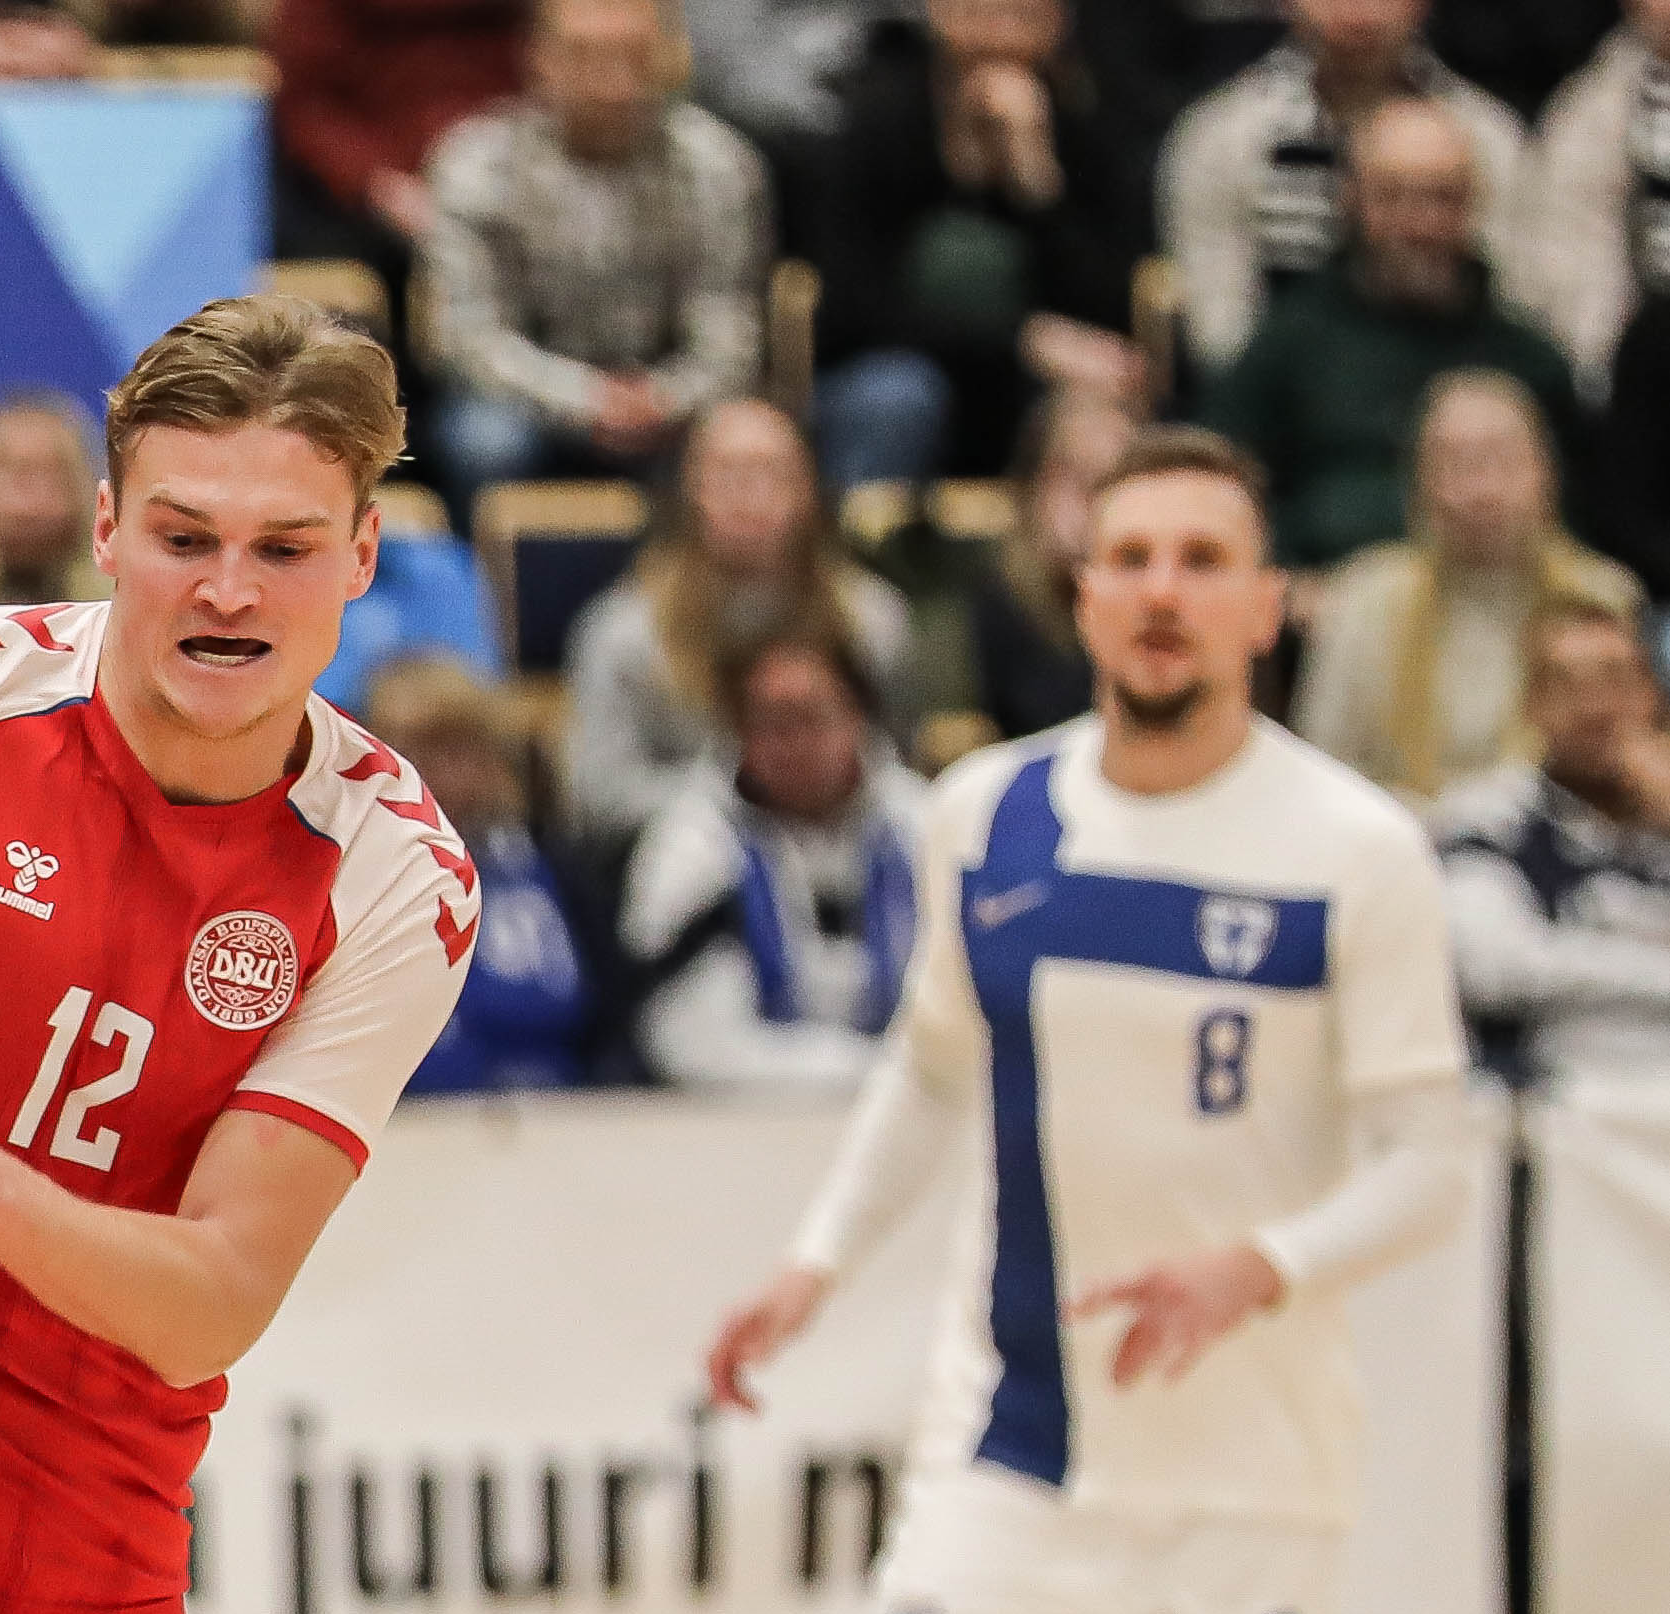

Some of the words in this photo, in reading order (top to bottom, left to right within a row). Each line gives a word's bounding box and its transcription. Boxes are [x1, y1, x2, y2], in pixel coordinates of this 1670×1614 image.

[191, 935, 215, 1002] DANSK
[263, 957, 294, 1016] UNION
[209, 947, 279, 990] DBU
[7, 985, 155, 1172] 12
[1194, 1007, 1253, 1115] 8
